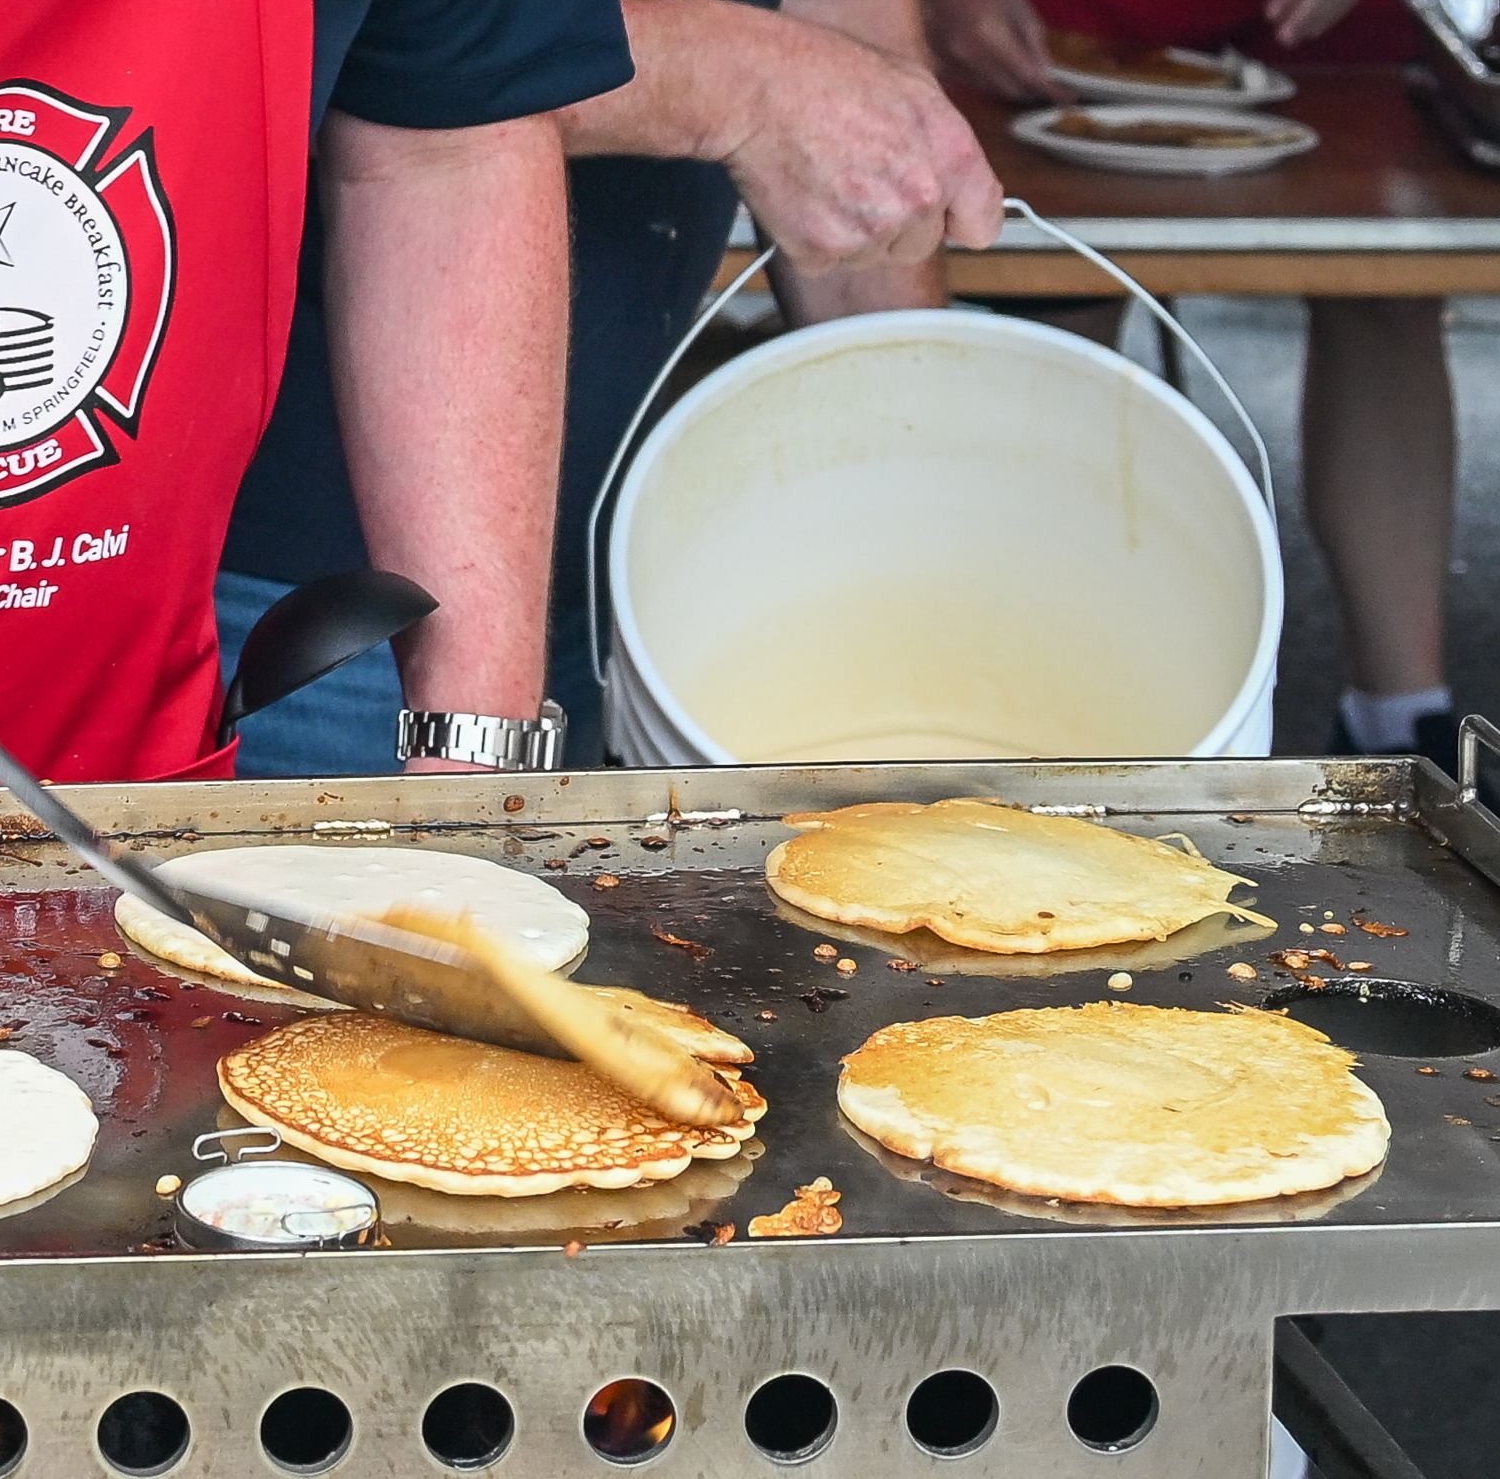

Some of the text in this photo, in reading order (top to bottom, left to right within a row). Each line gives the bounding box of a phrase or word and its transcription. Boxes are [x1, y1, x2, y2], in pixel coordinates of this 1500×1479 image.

[22, 328, 106, 425] SPRINGFIELD
[9, 540, 37, 573] B.
[41, 537, 65, 568] J.
[71, 525, 130, 564] Calvi
